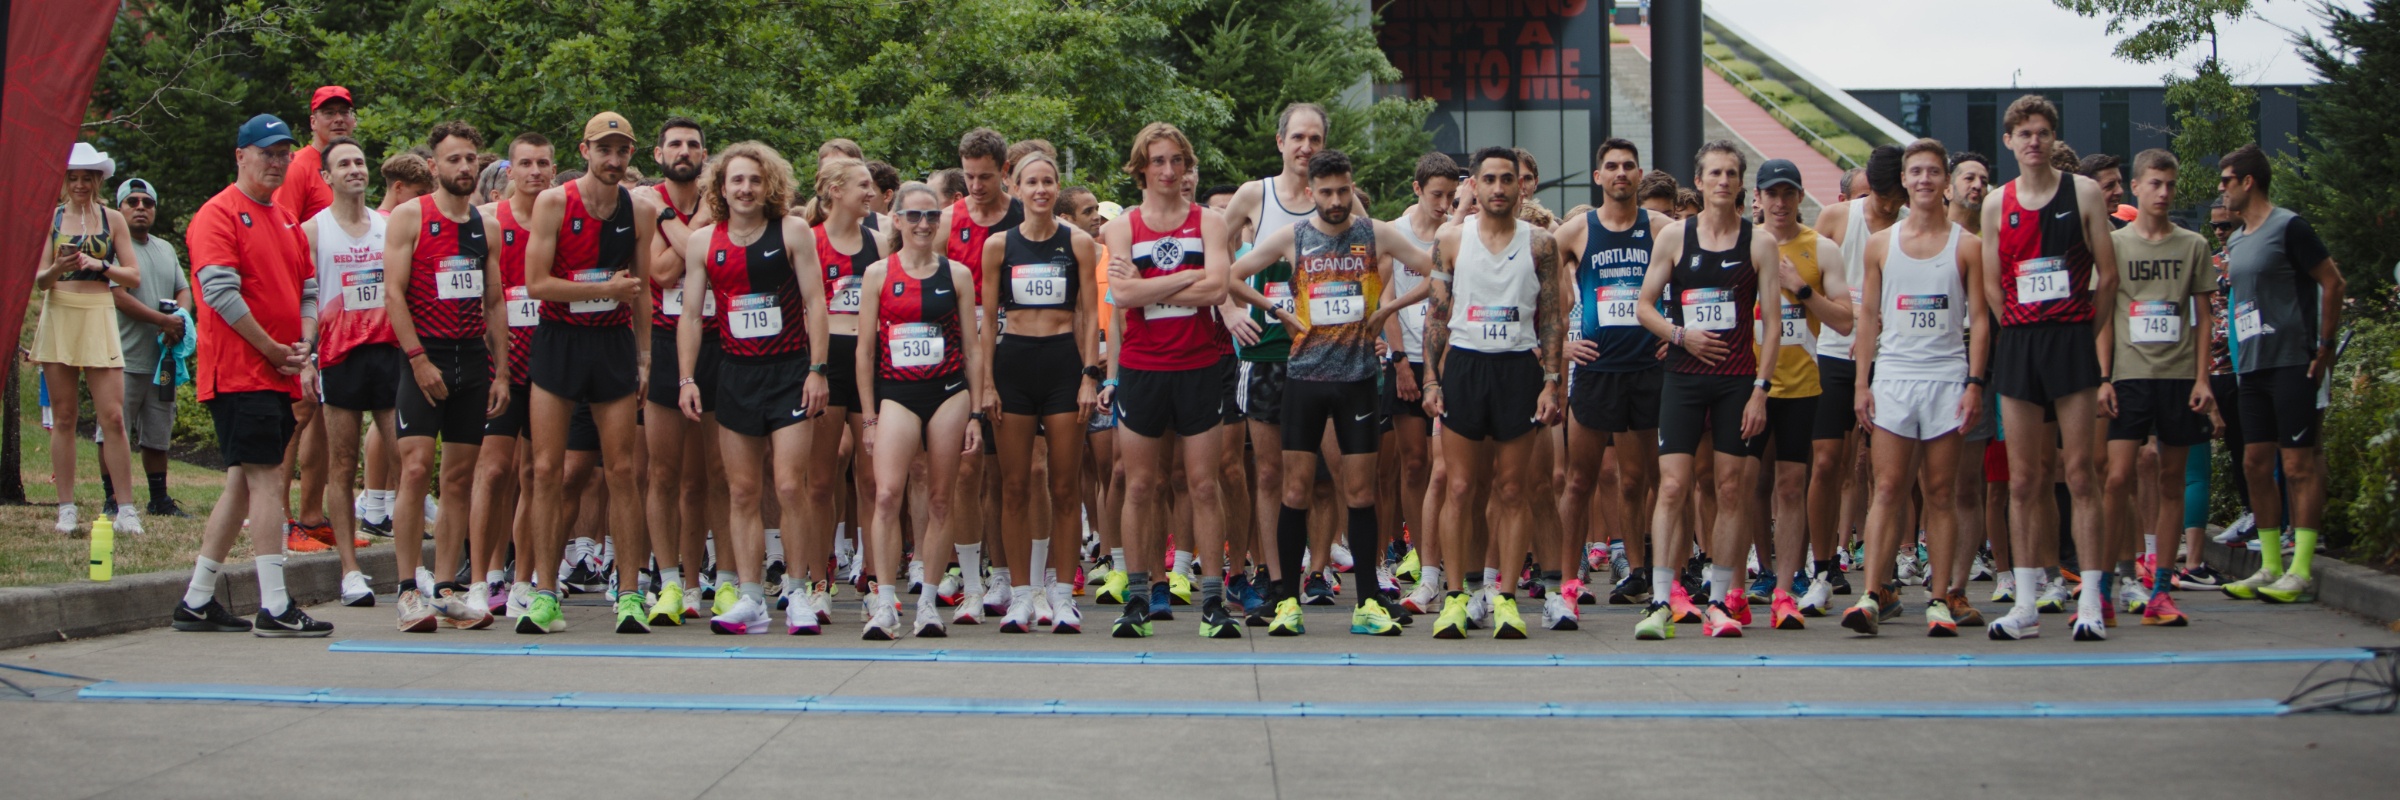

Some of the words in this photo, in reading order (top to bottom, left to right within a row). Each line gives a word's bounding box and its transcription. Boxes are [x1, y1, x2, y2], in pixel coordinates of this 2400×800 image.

[1516, 21, 1554, 45] A
[1458, 50, 1510, 100] TO
[1519, 48, 1590, 100] ME.
[333, 254, 353, 264] RED
[354, 252, 384, 263] LIZAR
[349, 246, 370, 254] TEAM
[439, 258, 470, 268] BOWERMAN
[1304, 256, 1365, 273] UGANDA
[1591, 248, 1649, 270] PORTLAND
[573, 272, 608, 281] BOWERMAN
[1599, 267, 1631, 279] RUNNING
[1632, 266, 1645, 277] CO.
[2128, 259, 2183, 281] USATF
[451, 272, 473, 289] 419
[1025, 280, 1053, 296] 469
[2029, 275, 2053, 293] 731
[356, 285, 378, 302] 167
[842, 290, 860, 306] 35
[1313, 286, 1348, 295] BOWERMAN
[1686, 290, 1720, 300] BOWERMAN
[521, 301, 536, 318] 41
[731, 296, 765, 307] BOWERMAN
[1324, 299, 1350, 316] 143
[1608, 302, 1635, 317] 484
[742, 311, 768, 329] 719
[1696, 305, 1722, 322] 578
[1910, 312, 1936, 328] 738
[893, 326, 928, 335] BOWERMAN
[1482, 323, 1508, 340] 144
[2143, 318, 2168, 333] 748
[903, 340, 930, 357] 530
